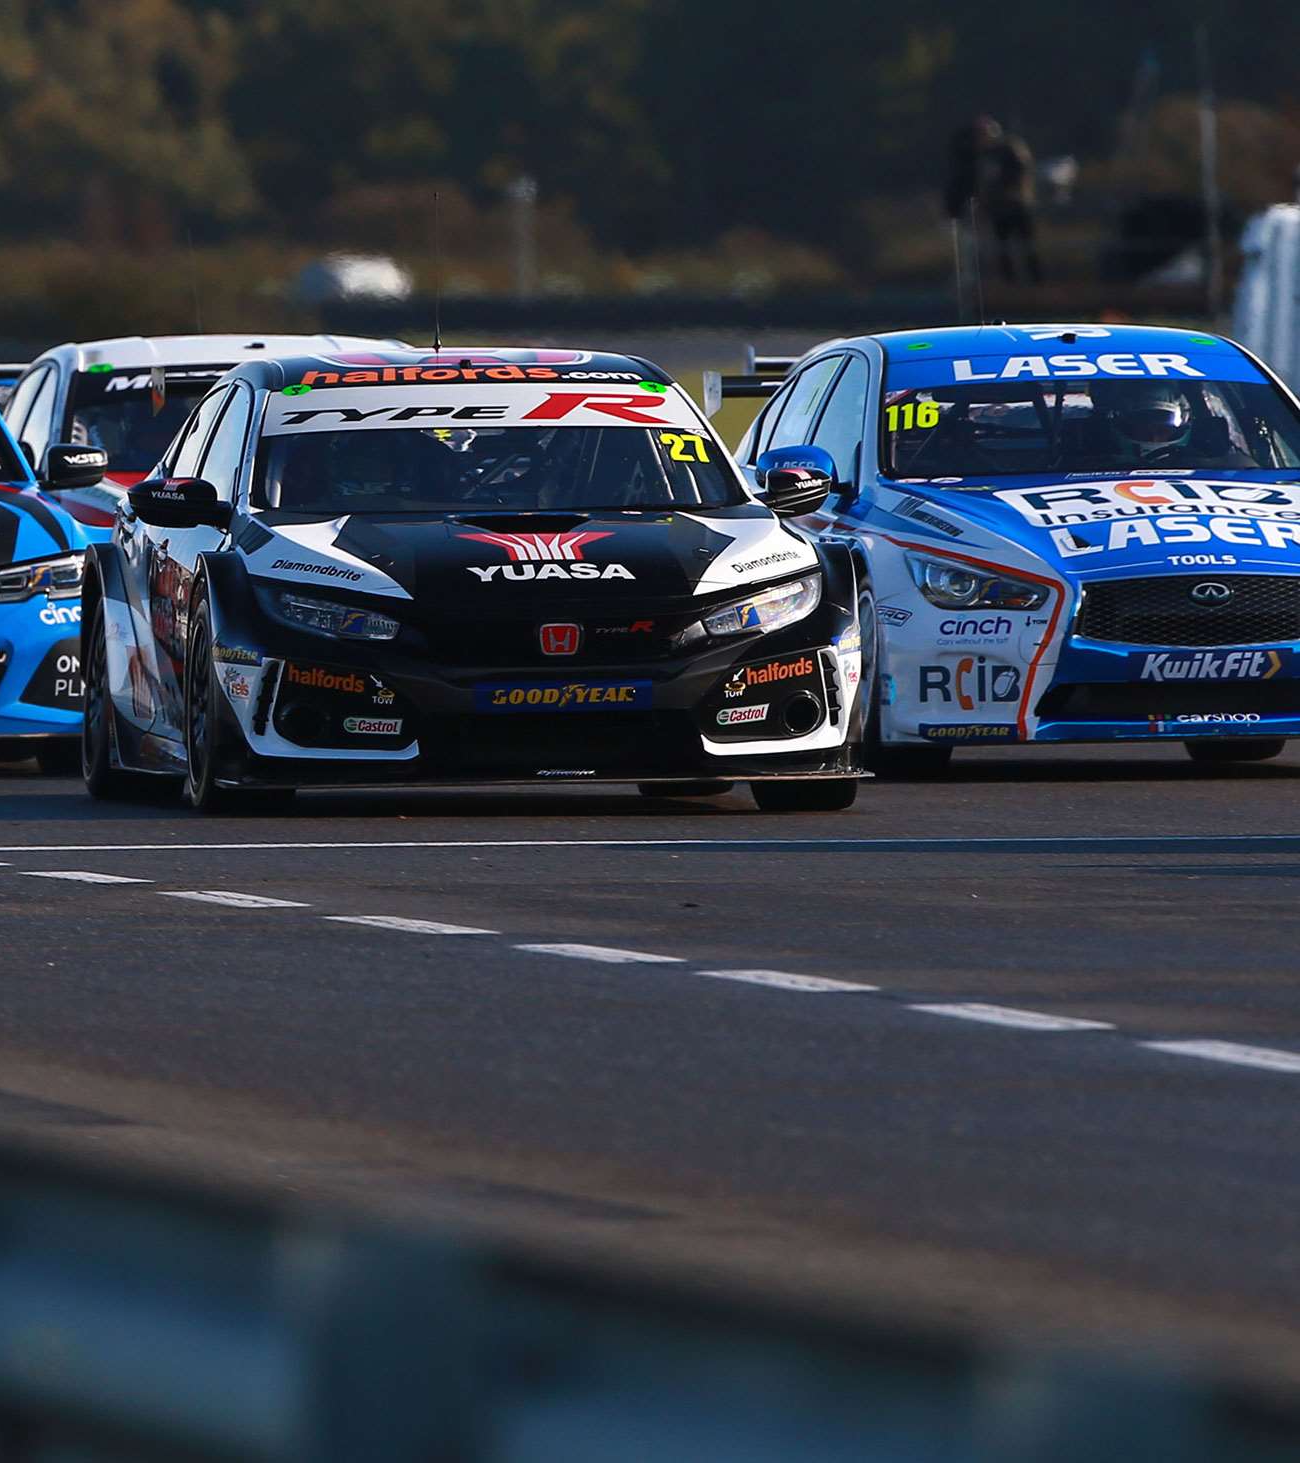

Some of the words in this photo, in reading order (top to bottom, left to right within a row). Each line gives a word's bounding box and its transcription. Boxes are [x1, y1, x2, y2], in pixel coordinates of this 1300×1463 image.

[301, 366, 643, 386] halfords.com
[953, 353, 1207, 381] LASER
[281, 405, 509, 426] TYPE
[519, 392, 678, 424] R
[885, 402, 940, 432] 116
[660, 433, 711, 463] 27
[151, 491, 186, 501] YUASA
[1049, 516, 1300, 558] LASER
[271, 559, 363, 582] Diamondbrite
[731, 550, 801, 574] Diamondbrite
[1167, 555, 1237, 566] TOOLS
[466, 563, 637, 582] YUASA
[939, 616, 1013, 636] cinch
[56, 655, 81, 673] ON
[746, 656, 814, 685] halfords
[287, 663, 366, 693] halfords
[372, 695, 395, 705] TOW
[729, 706, 765, 722] Castrol
[1176, 712, 1261, 727] carshop
[357, 719, 398, 733] Castrol
[927, 724, 1011, 738] GOODYEAR
